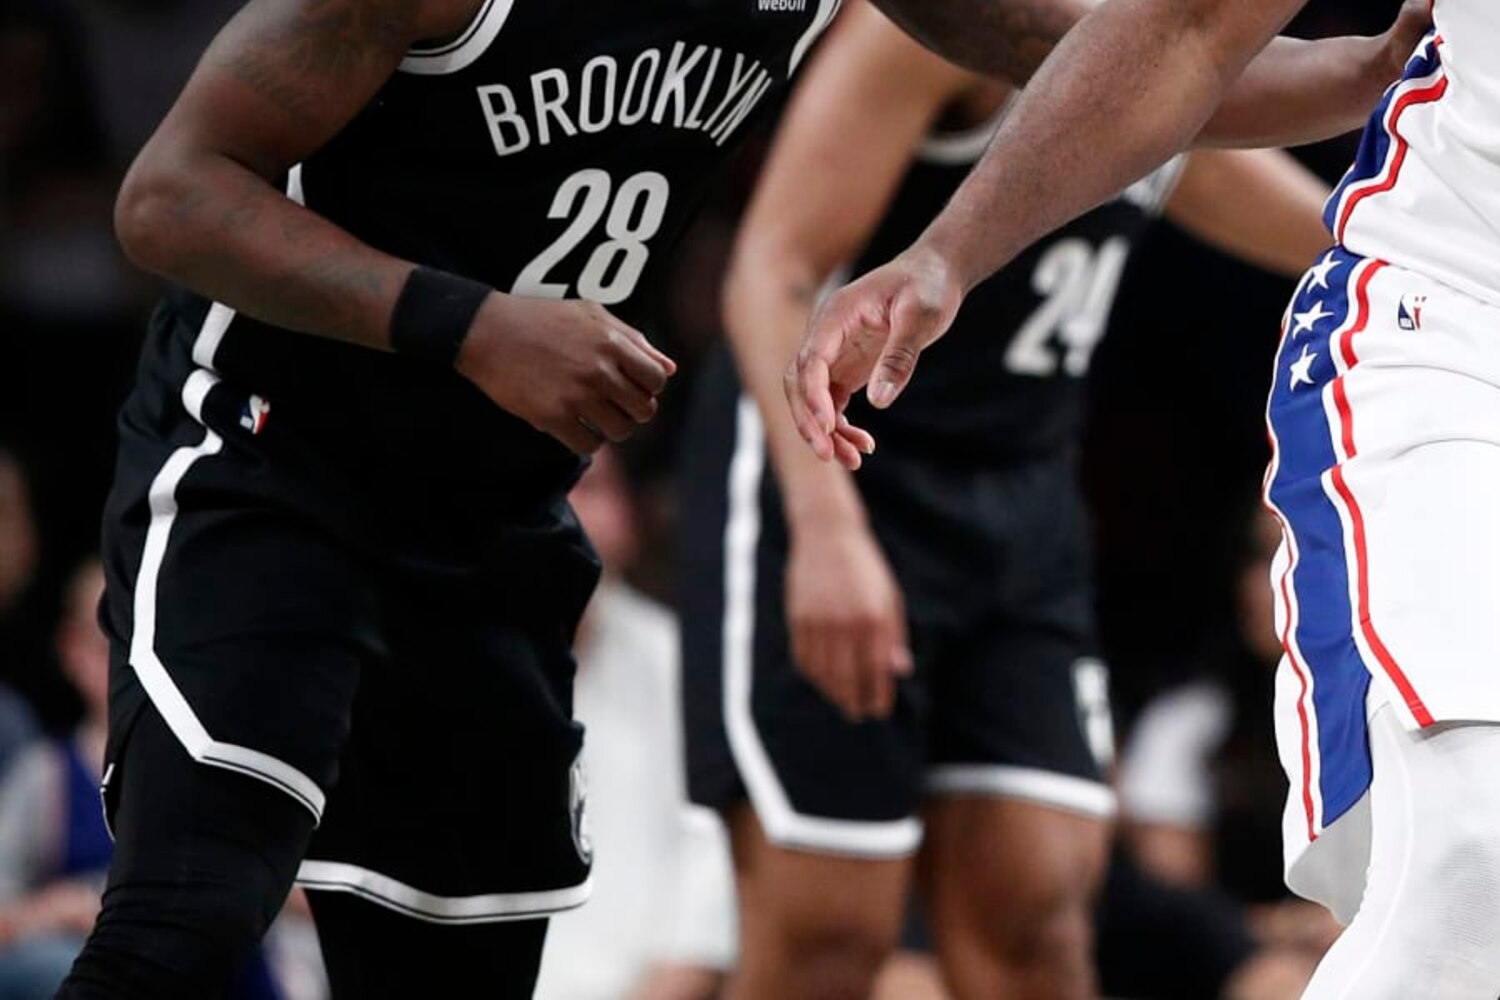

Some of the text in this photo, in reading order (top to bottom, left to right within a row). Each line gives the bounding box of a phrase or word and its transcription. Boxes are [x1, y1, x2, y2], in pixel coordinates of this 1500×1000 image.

[476, 40, 772, 157] BROOKLYN
[509, 168, 670, 306] 28
[1003, 236, 1130, 379] 24
